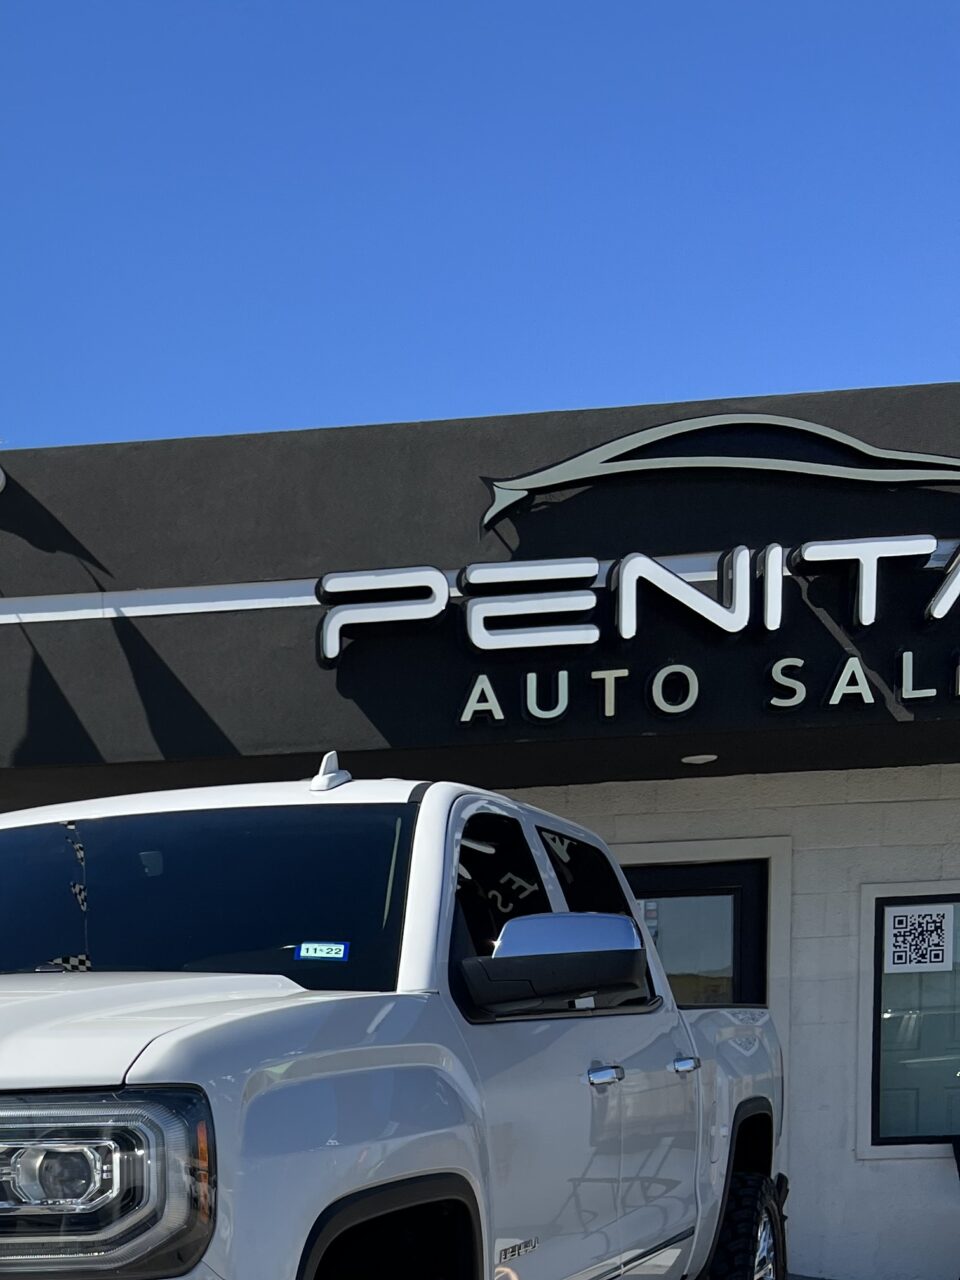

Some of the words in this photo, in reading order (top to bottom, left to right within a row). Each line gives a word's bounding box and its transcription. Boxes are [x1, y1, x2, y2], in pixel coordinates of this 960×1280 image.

[320, 534, 960, 659] PENIT
[459, 664, 700, 722] AUTO
[770, 651, 960, 707] SAL
